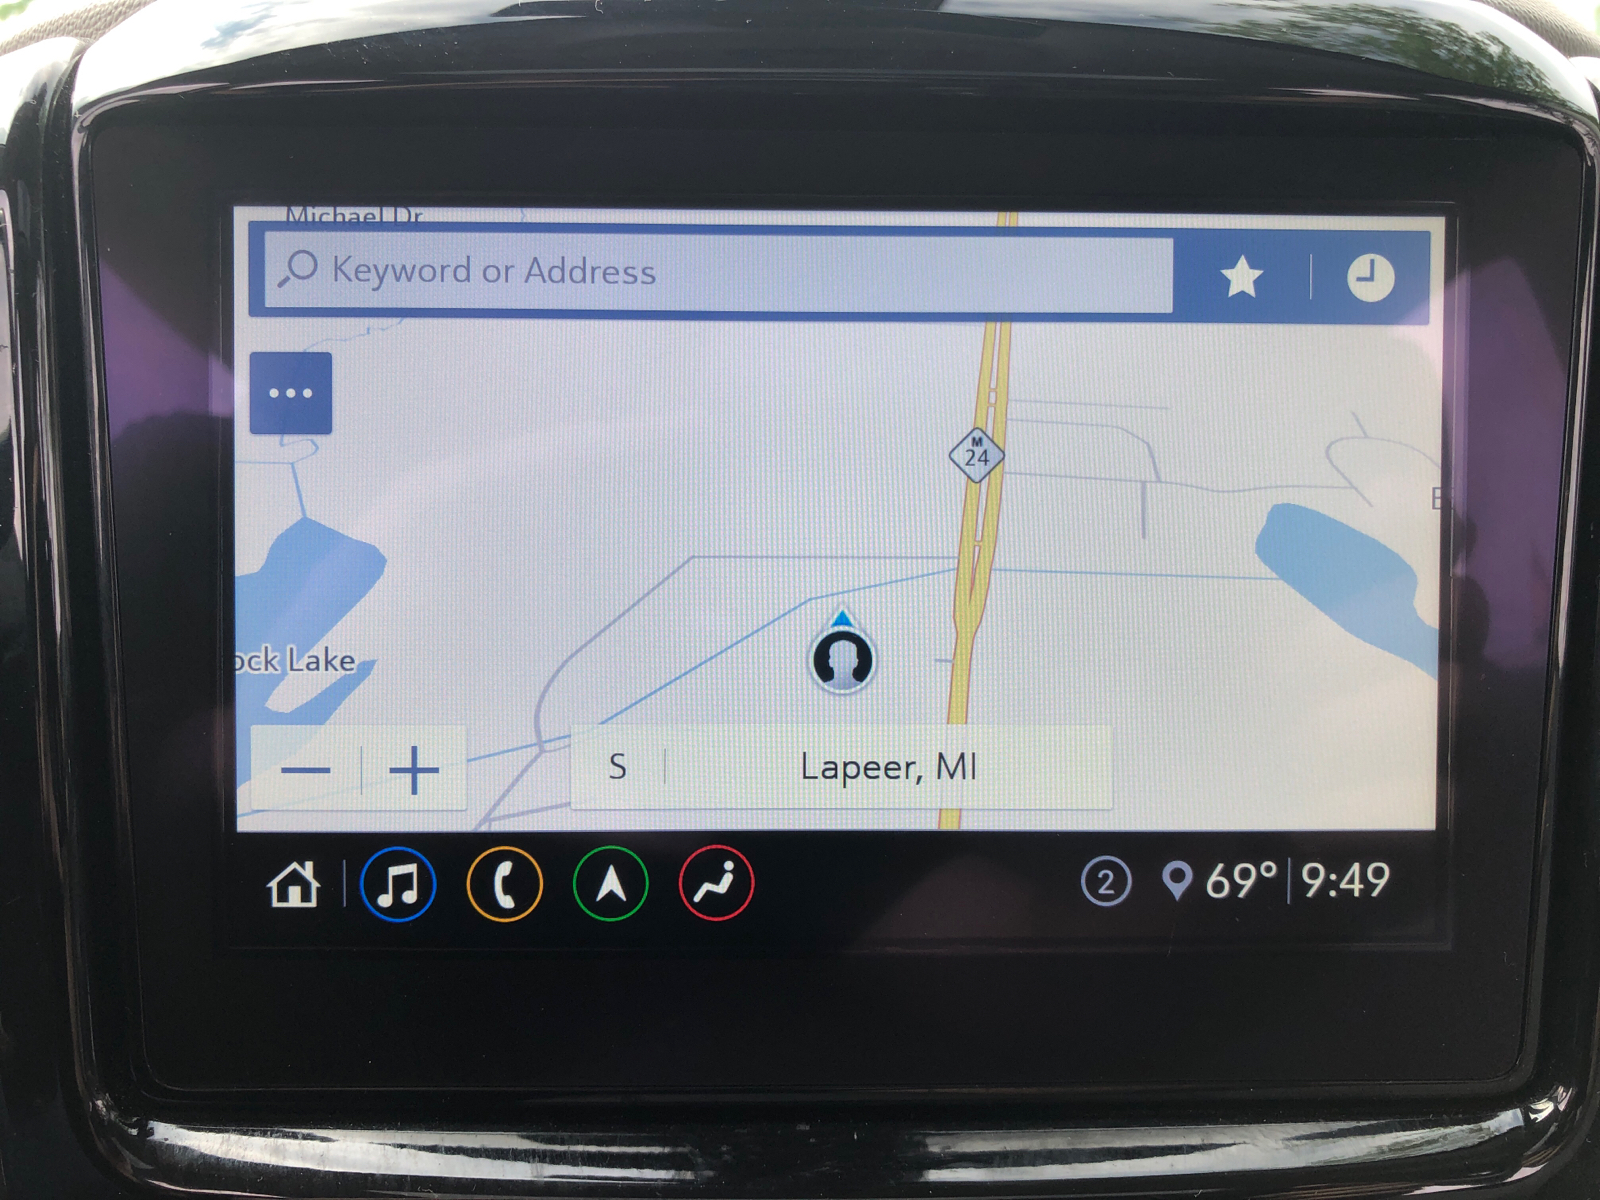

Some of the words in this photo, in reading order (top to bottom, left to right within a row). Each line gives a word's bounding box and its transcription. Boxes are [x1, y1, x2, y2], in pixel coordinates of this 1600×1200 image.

[286, 206, 384, 225] Michael
[394, 206, 424, 225] Dr
[333, 255, 471, 291] Keyword
[482, 263, 514, 284] or
[524, 256, 656, 285] Address
[971, 436, 983, 448] M
[965, 449, 990, 466] 24
[289, 646, 356, 672] Lake
[609, 753, 627, 779] S
[801, 752, 924, 788] Lapeer,
[936, 752, 977, 780] MI
[1097, 869, 1115, 895] 2
[1301, 862, 1391, 898] 9:49
